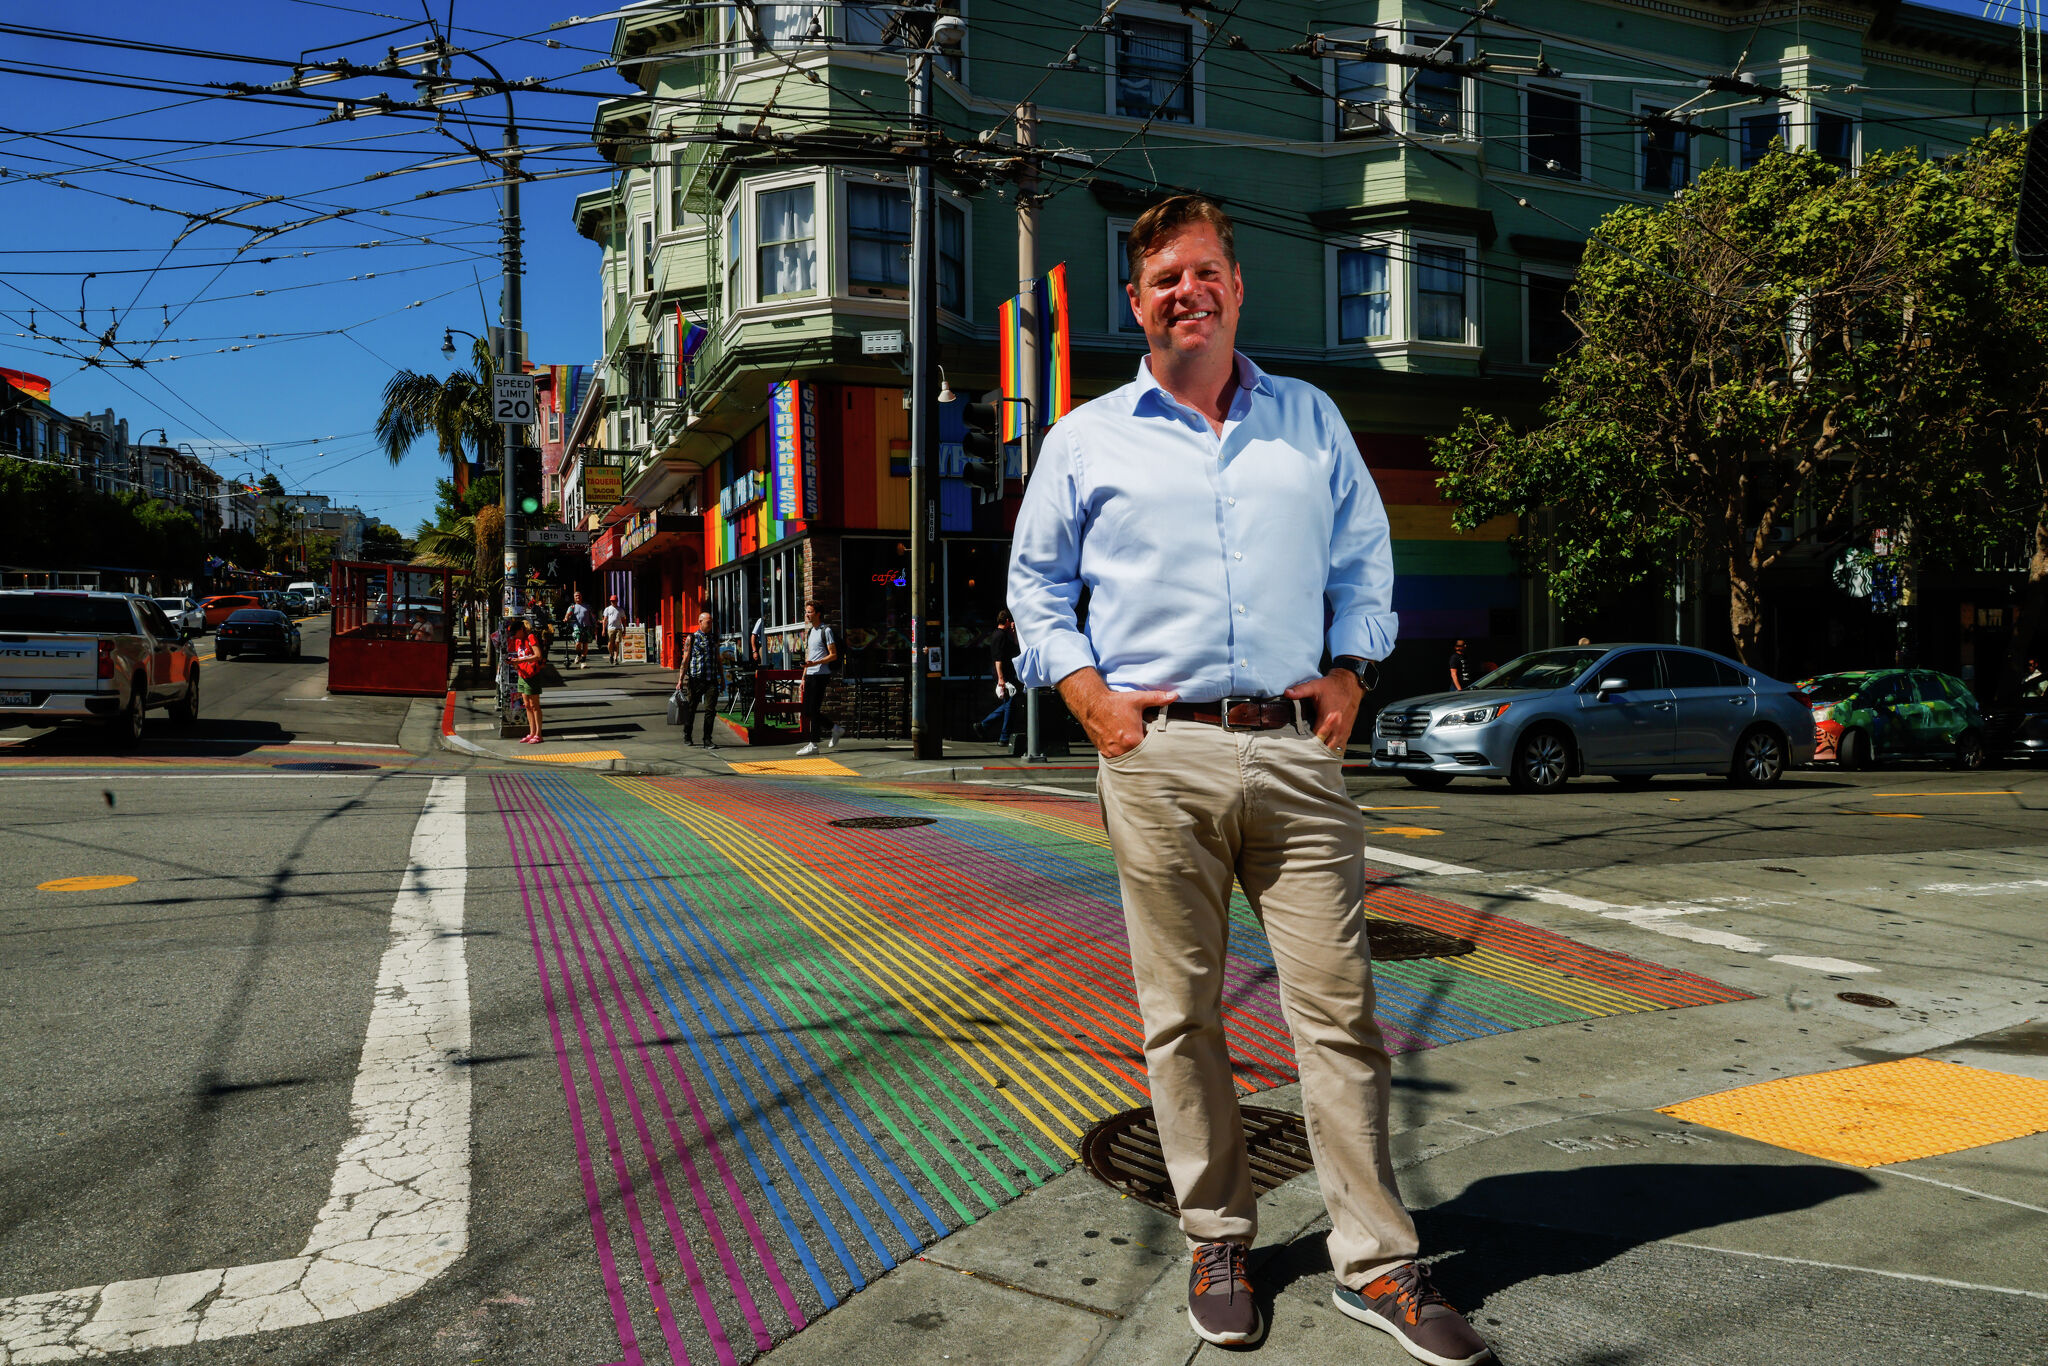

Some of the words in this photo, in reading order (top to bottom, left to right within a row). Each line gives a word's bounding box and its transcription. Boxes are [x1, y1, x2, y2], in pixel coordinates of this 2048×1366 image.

[496, 379, 531, 389] SPEED
[500, 389, 527, 398] LIMIT
[498, 400, 530, 419] 20
[774, 386, 797, 514] GYROXPRESS
[586, 477, 621, 486] TAQUERIA
[539, 532, 559, 541] 18th
[564, 532, 576, 542] St
[871, 569, 899, 586] café
